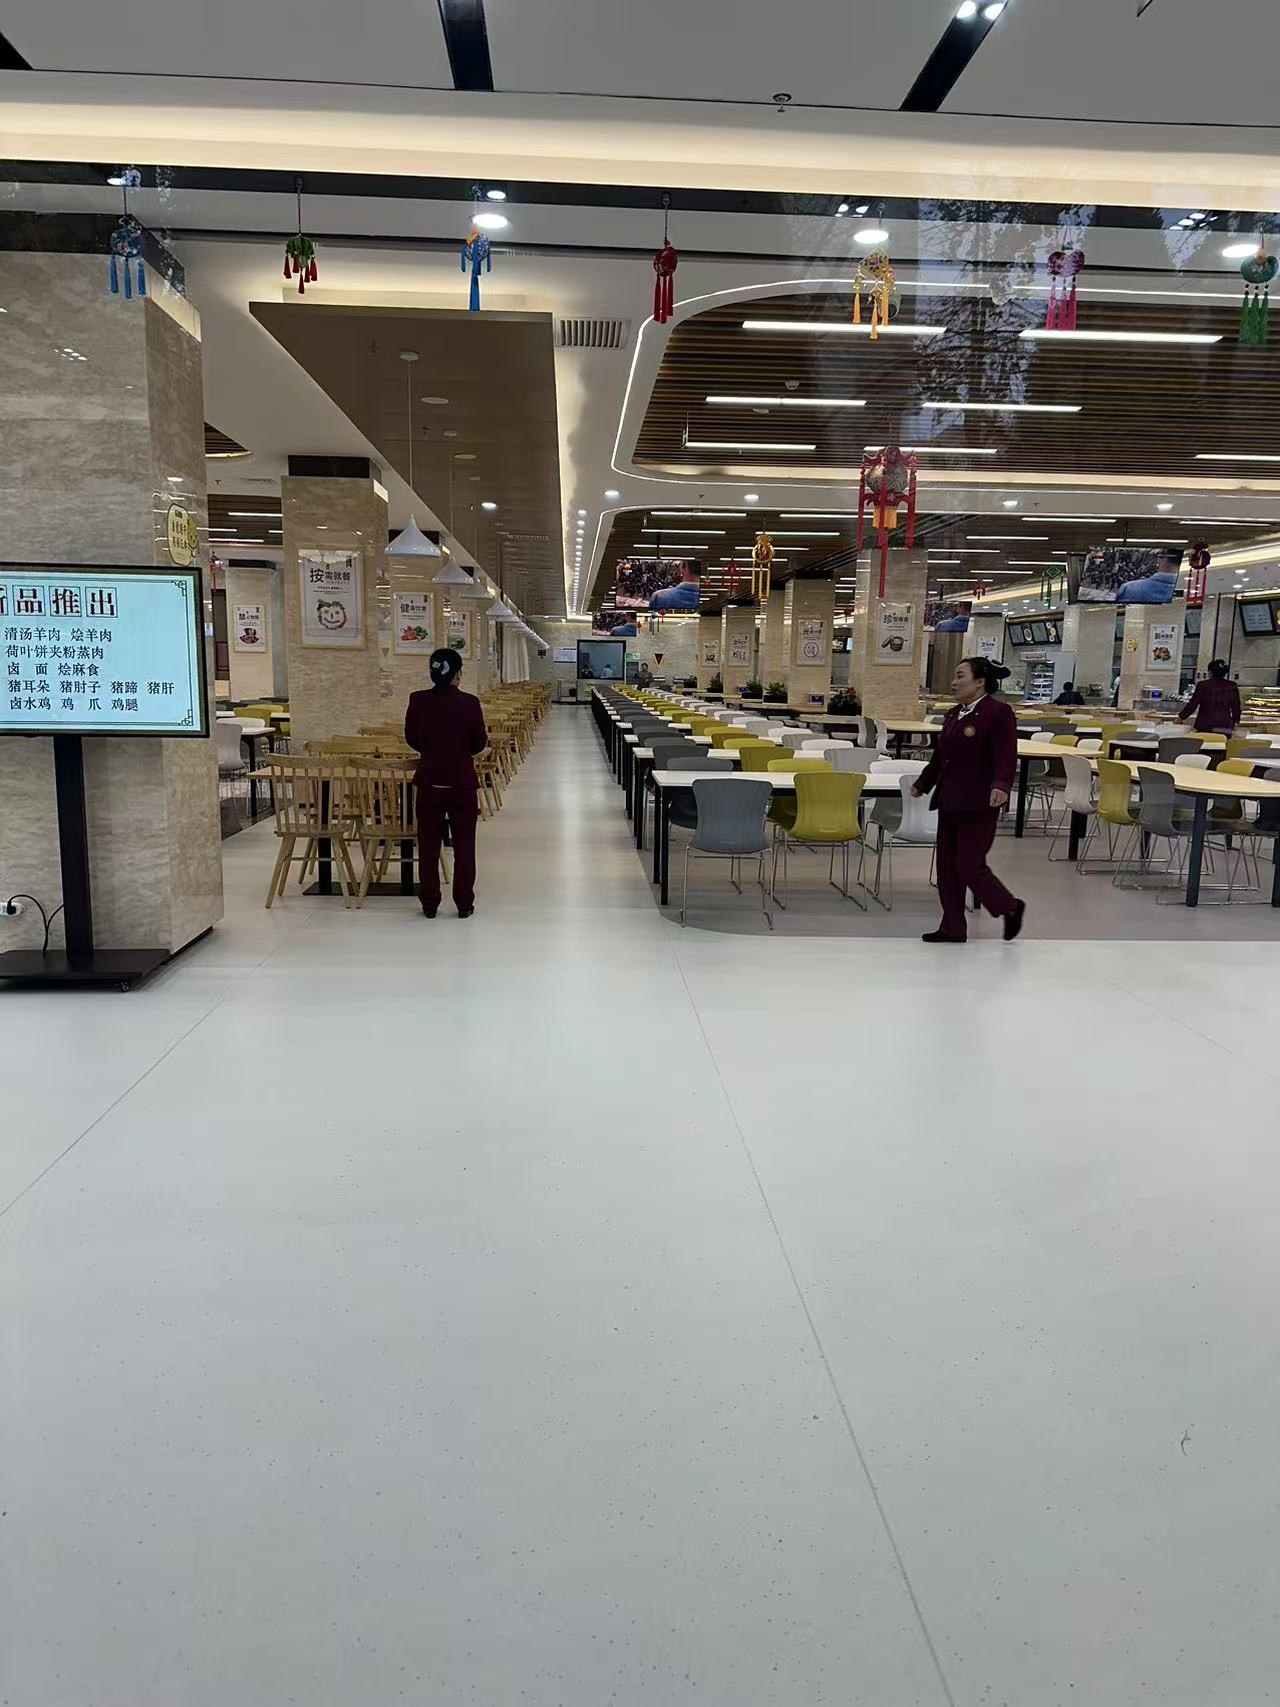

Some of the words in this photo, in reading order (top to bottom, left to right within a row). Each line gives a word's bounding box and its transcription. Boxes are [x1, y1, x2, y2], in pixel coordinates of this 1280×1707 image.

[4, 627, 61, 641] 清汤羊肉
[70, 628, 112, 642] 烩羊肉
[5, 645, 104, 659] 荷叶饼夹粉蒸肉
[57, 663, 100, 677] 烩麻食
[7, 679, 50, 693] 猪耳朵
[59, 680, 101, 694] 猪肘子
[110, 681, 138, 695] 猪蹄
[146, 681, 174, 695] 猪肝
[9, 697, 51, 711] 卤水鸡
[111, 698, 139, 712] 鸡腿
